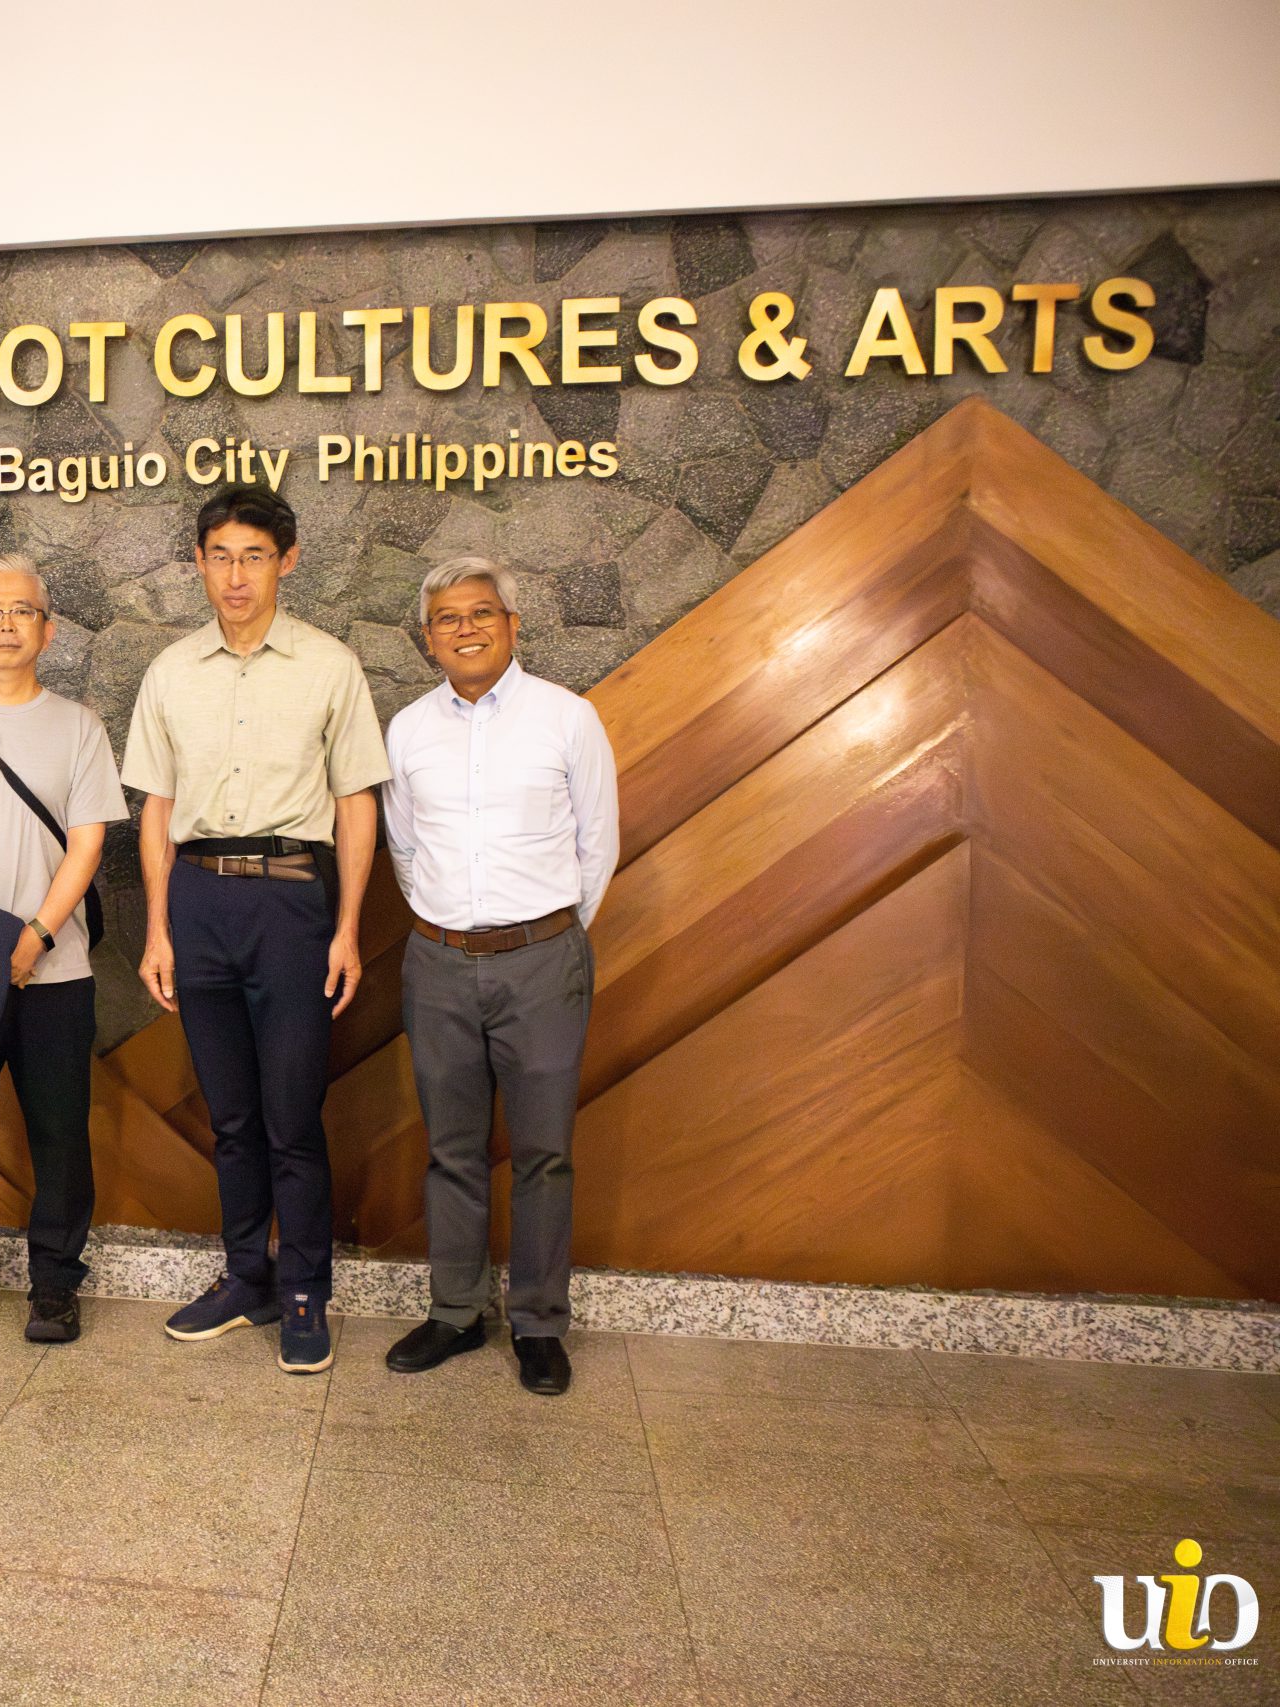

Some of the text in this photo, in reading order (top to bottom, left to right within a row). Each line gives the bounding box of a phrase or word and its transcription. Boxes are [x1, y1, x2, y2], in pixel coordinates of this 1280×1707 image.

[154, 296, 699, 397] CULTURES
[737, 291, 813, 382] &
[844, 277, 1156, 377] ARTS
[185, 436, 290, 493] City
[318, 429, 619, 492] Philippines
